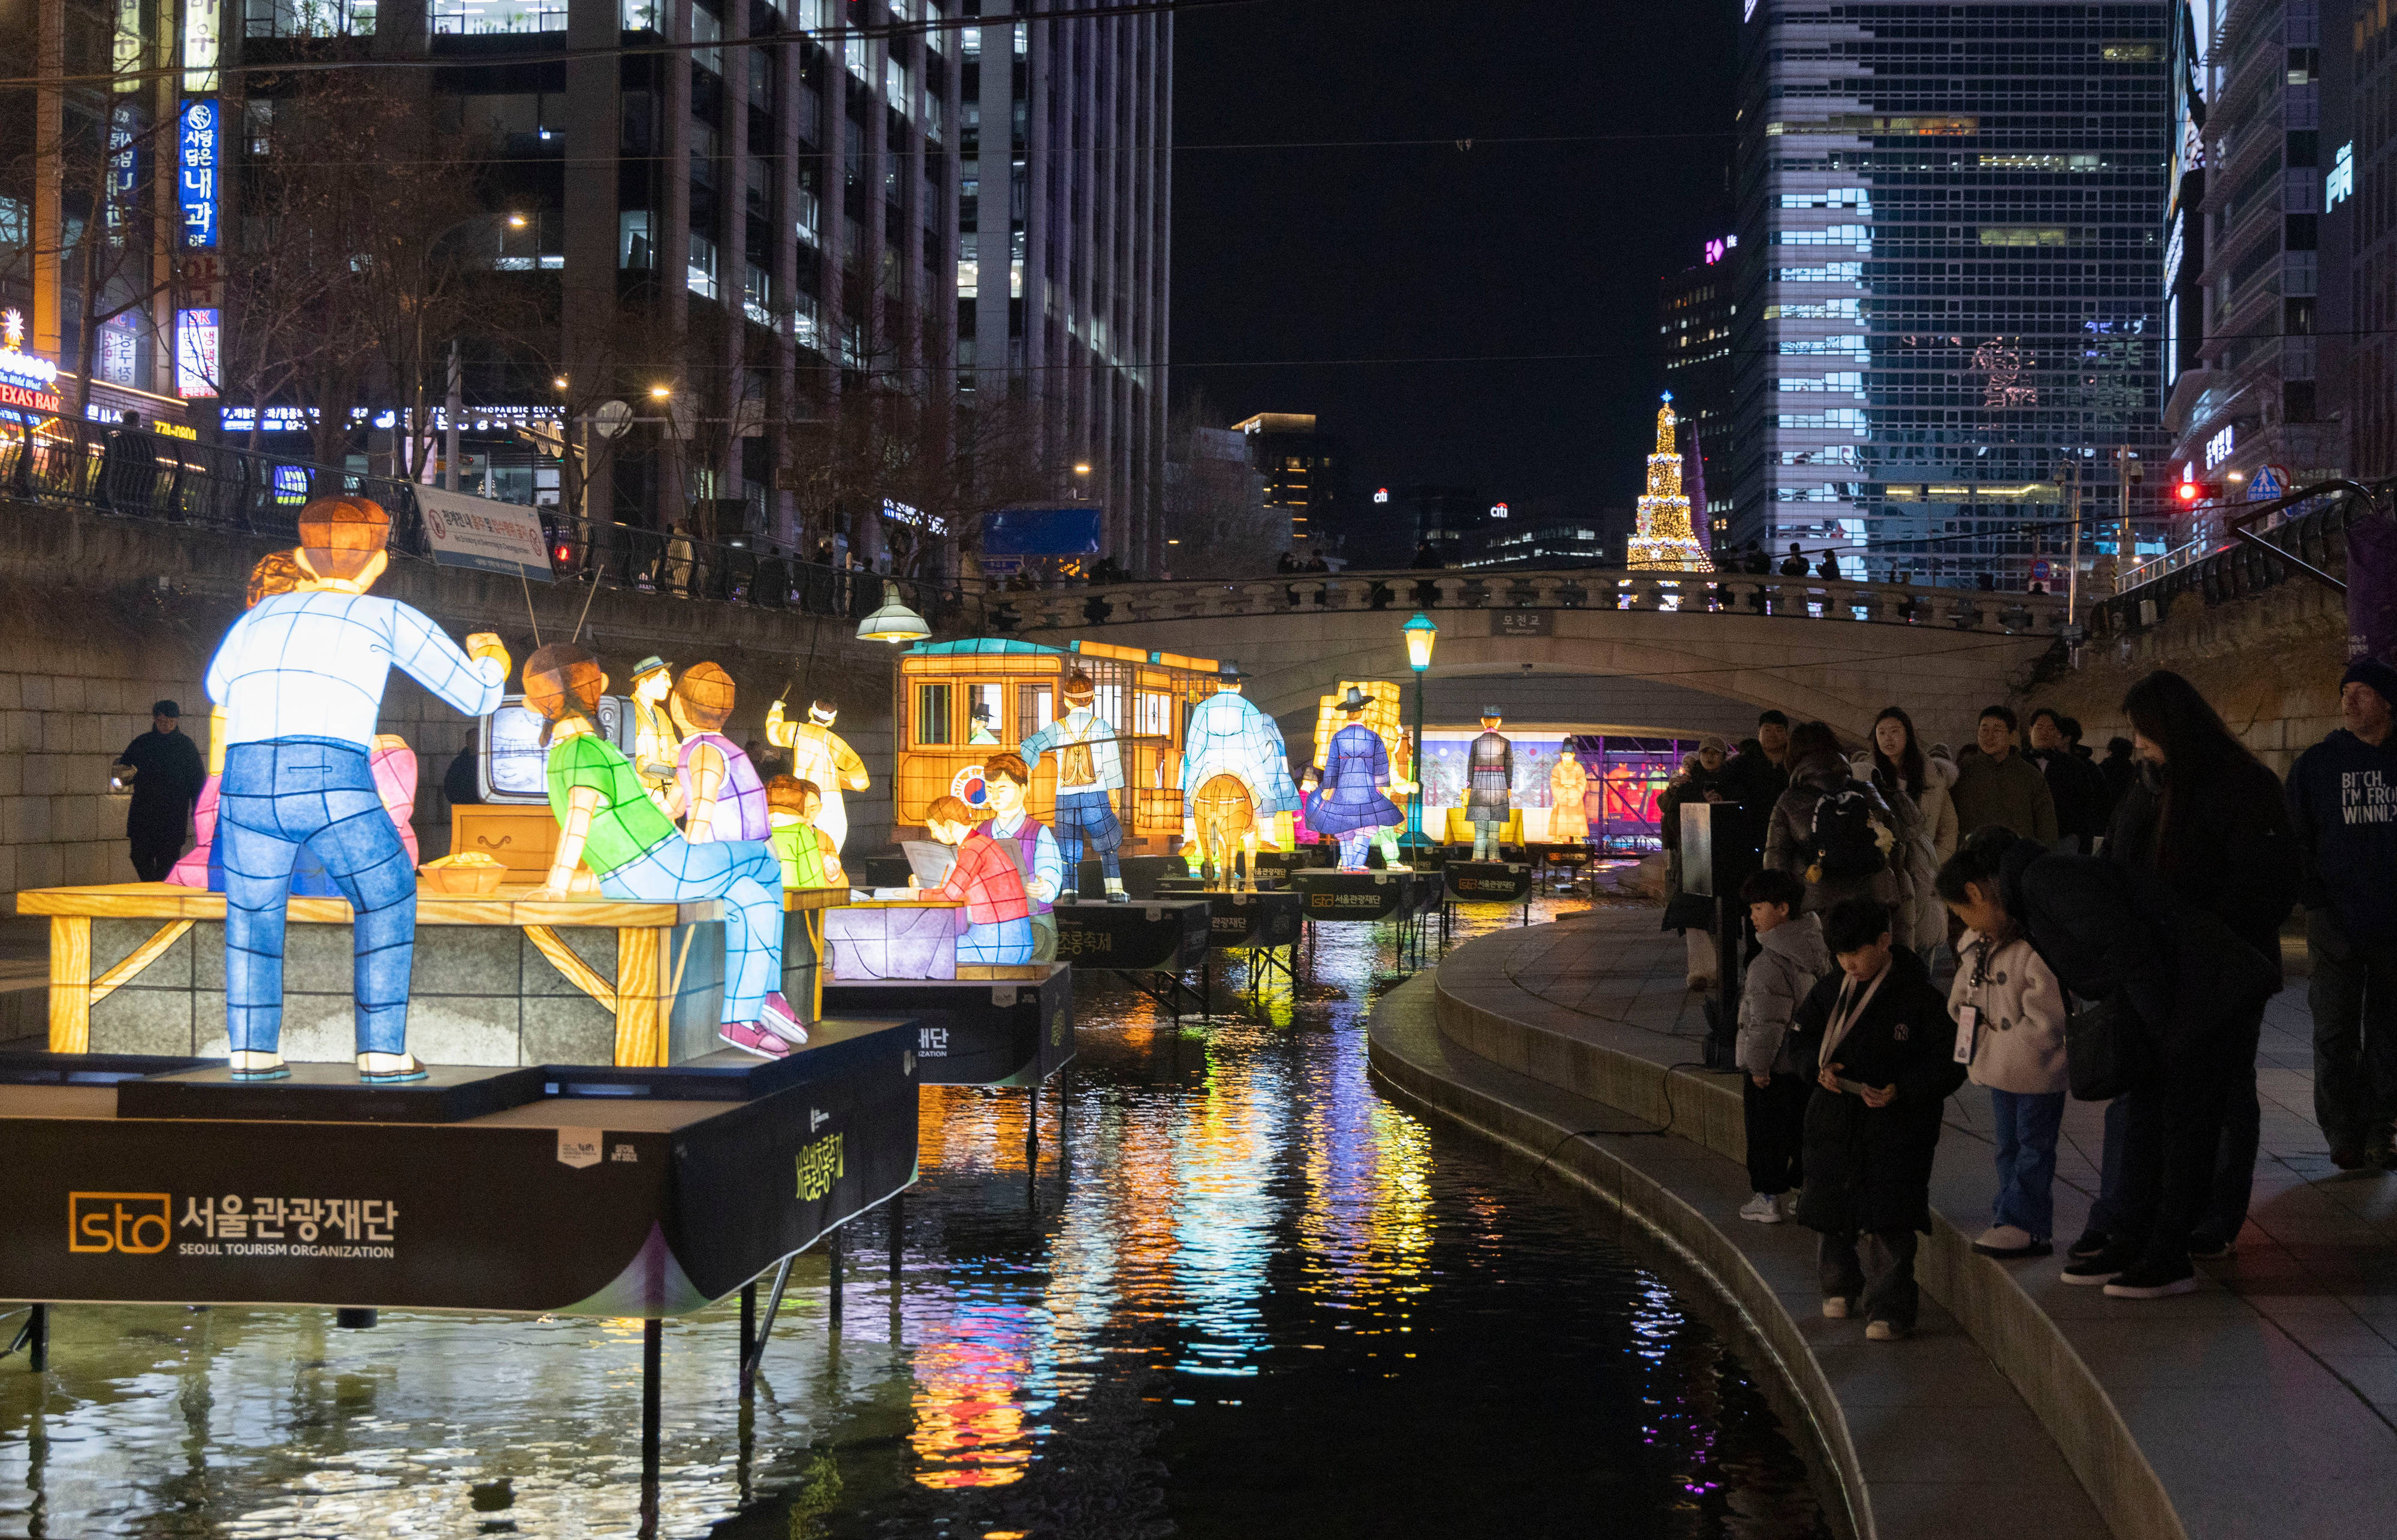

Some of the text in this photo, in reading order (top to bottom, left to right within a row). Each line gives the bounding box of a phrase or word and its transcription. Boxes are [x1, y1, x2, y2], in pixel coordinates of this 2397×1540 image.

[185, 129, 213, 149] 사랑
[185, 148, 213, 167] 담은
[185, 168, 212, 233] 내과
[188, 310, 210, 325] OK
[35, 392, 60, 412] BAR
[533, 406, 566, 414] CLIC
[1373, 488, 1388, 503] citi
[1490, 503, 1508, 518] citi
[1503, 615, 1540, 626] 모전교
[2342, 770, 2386, 789] BICH,
[2342, 788, 2360, 806] I'M
[1335, 894, 1381, 904] 서울관광재단
[69, 1191, 171, 1254] sto
[180, 1194, 398, 1241] 서울관광재단
[180, 1243, 394, 1258] SEOUL TOURISM ORGANIZATION
